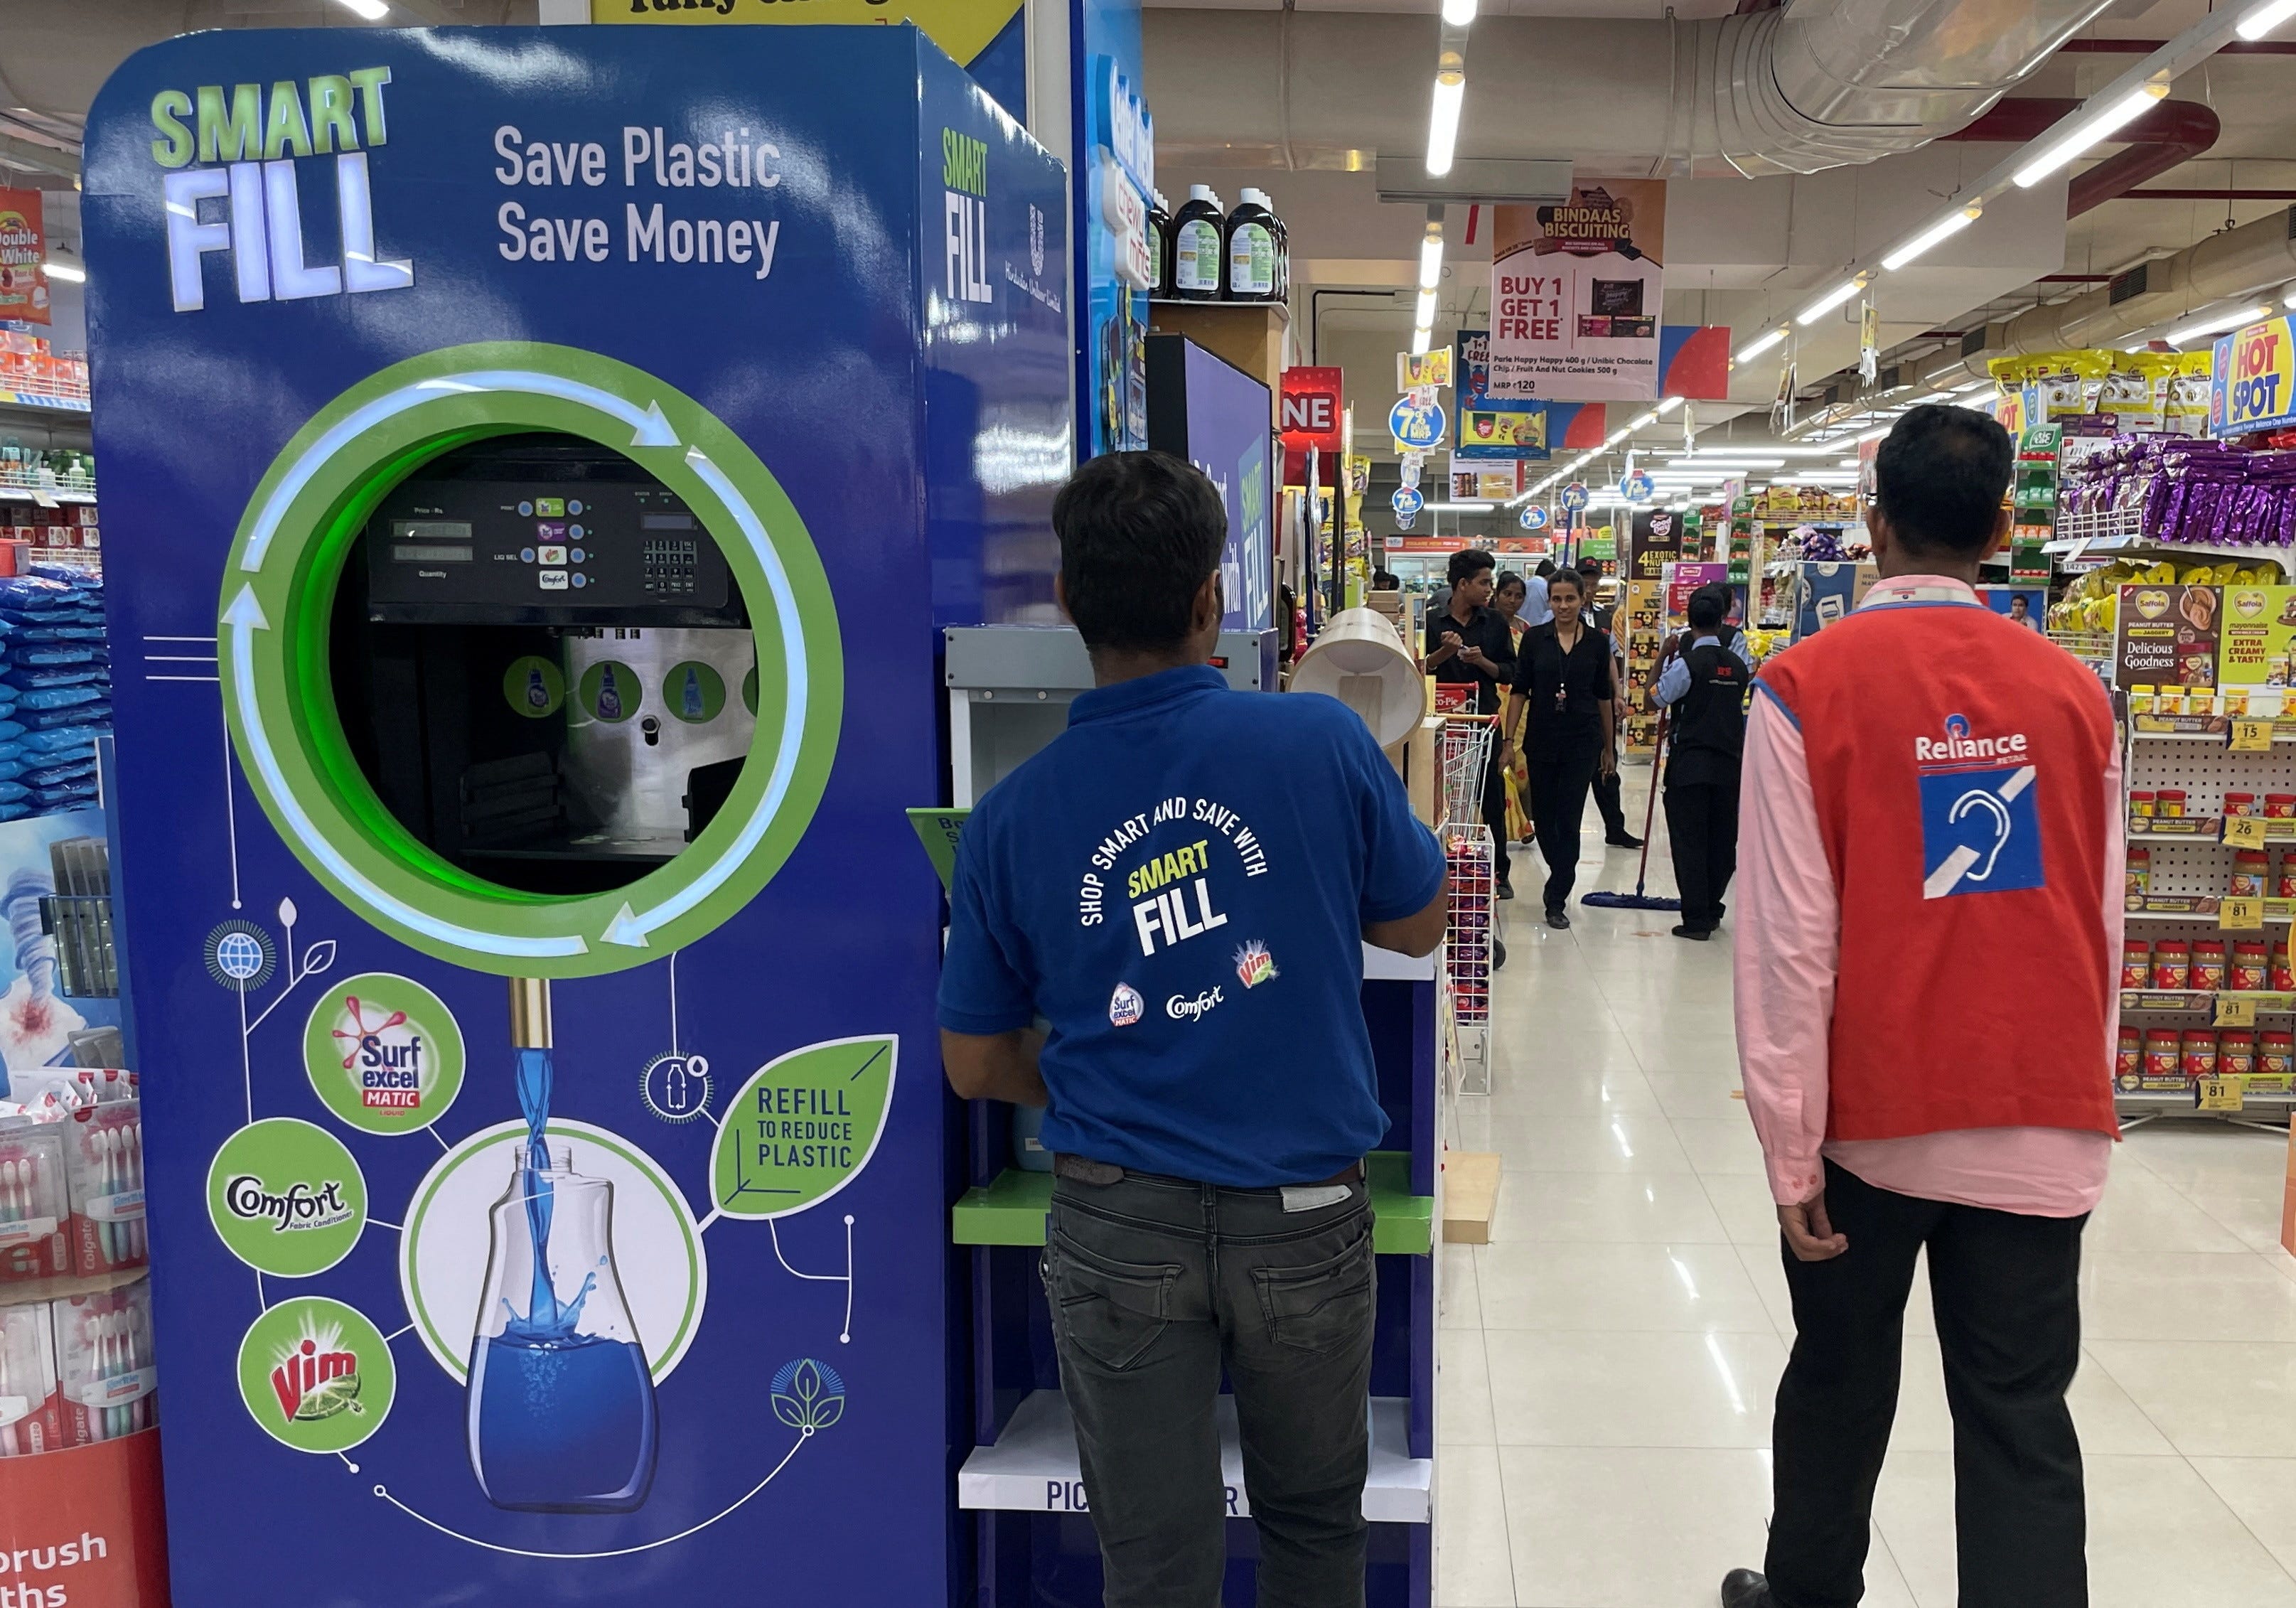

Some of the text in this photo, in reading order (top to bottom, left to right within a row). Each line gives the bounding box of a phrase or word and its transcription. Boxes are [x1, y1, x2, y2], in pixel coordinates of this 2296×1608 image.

[150, 66, 391, 168] SMART
[495, 125, 782, 188] Save Plastic
[943, 127, 988, 198] SMART
[1553, 208, 1622, 224] BINDAAS
[163, 151, 414, 312] FILL
[498, 201, 780, 280] Save Money
[1544, 223, 1630, 239] BISCUITING
[2, 247, 40, 264] White
[945, 190, 992, 304] FILL
[1501, 277, 1562, 296] BUY 1
[1500, 299, 1559, 318] GET 1
[1493, 355, 1512, 364] Parle
[1514, 356, 1538, 366] Happy
[1540, 357, 1563, 366] Happy
[1616, 358, 1653, 366] Chocolate
[2237, 334, 2279, 379] HOT
[1493, 365, 1510, 374] Chip
[1516, 365, 1534, 374] Fruit
[1493, 381, 1511, 390] MRP
[2233, 373, 2280, 422] SPOT
[1282, 398, 1331, 427] NE
[1240, 460, 1262, 534] SMART
[1637, 551, 1650, 567] 4
[1650, 551, 1677, 559] EXOTIC
[419, 570, 447, 579] Quantity
[1243, 519, 1270, 630] FILL
[2237, 599, 2263, 608] Saffola
[2127, 642, 2173, 655] Delicious
[2125, 655, 2174, 669] Goodness
[1434, 696, 1458, 706] co-Pie
[2243, 727, 2258, 738] 15
[1915, 733, 2027, 761] Reliance
[2236, 824, 2252, 835] 26
[1080, 797, 1267, 926] SHOP SMART AND SAVE WITH
[1127, 840, 1209, 899] SMART
[1132, 877, 1228, 957] FILL
[2233, 906, 2247, 916] 81
[1238, 952, 1271, 989] Vim
[1114, 996, 1135, 1010] Surf
[1114, 1009, 1136, 1017] excel
[1166, 985, 1224, 1022] Comfort
[2225, 1005, 2240, 1014] 81
[1115, 1017, 1136, 1027] MATIC
[362, 1035, 422, 1068] Surf
[363, 1067, 419, 1088] excel
[367, 1091, 416, 1106] MATIC
[758, 1087, 851, 1115] REFILL
[2209, 1086, 2226, 1097] 81
[757, 1120, 852, 1140] TO REDUCE
[758, 1143, 852, 1168] PLASTIC
[227, 1176, 345, 1231] Comfort
[313, 1211, 353, 1228] Conditioner
[83, 1220, 96, 1271] Colgate
[270, 1338, 356, 1422] Vim
[75, 1407, 86, 1445] lgate
[1047, 1481, 1088, 1511] PIC
